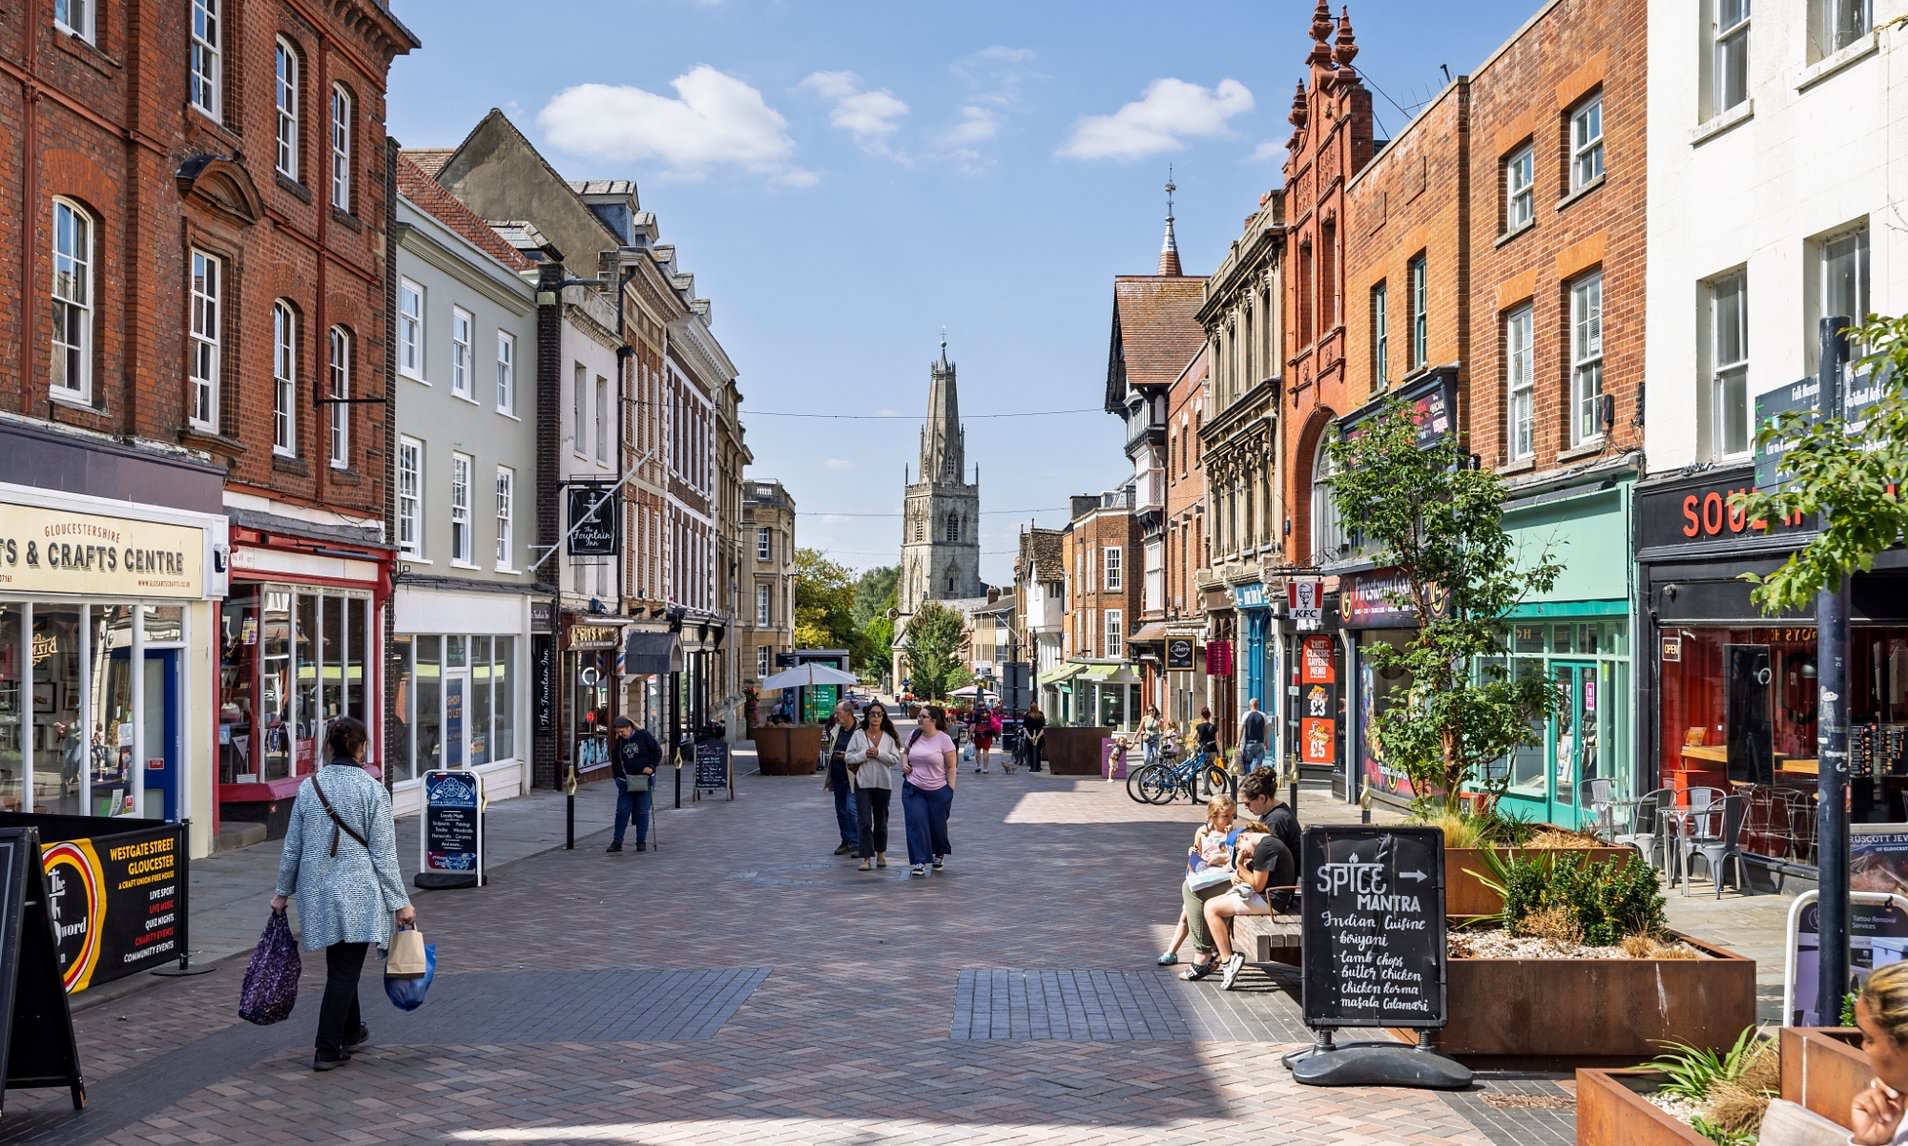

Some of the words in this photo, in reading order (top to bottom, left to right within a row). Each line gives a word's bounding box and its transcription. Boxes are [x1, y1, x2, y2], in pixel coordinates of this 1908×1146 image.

[45, 523, 121, 543] GLOUCESTERSHIRE
[574, 529, 611, 540] Fountain
[26, 540, 40, 566] &
[47, 542, 118, 570] CRAFTS
[124, 548, 184, 576] CENTRE
[1295, 609, 1317, 617] KFC
[1664, 644, 1679, 655] OPEN
[540, 669, 549, 705] Fountain
[1310, 700, 1326, 716] £3
[1310, 741, 1326, 758] £5
[110, 843, 149, 861] WESTGATE
[150, 838, 174, 854] STREET
[128, 855, 174, 875] GLOUCESTER
[1317, 862, 1386, 896] SPICE
[150, 890, 160, 900] LIVE
[161, 886, 174, 897] SPORT
[1357, 894, 1421, 912] MANTRA
[145, 919, 158, 931] QUIZ
[158, 913, 175, 925] NIGHTS
[1321, 911, 1376, 927] Indian
[1384, 915, 1426, 930] Cuisine
[123, 947, 156, 962] COMMUNITY
[156, 941, 174, 954] EVENTS
[1383, 982, 1419, 995] korma
[1341, 996, 1379, 1009] masala
